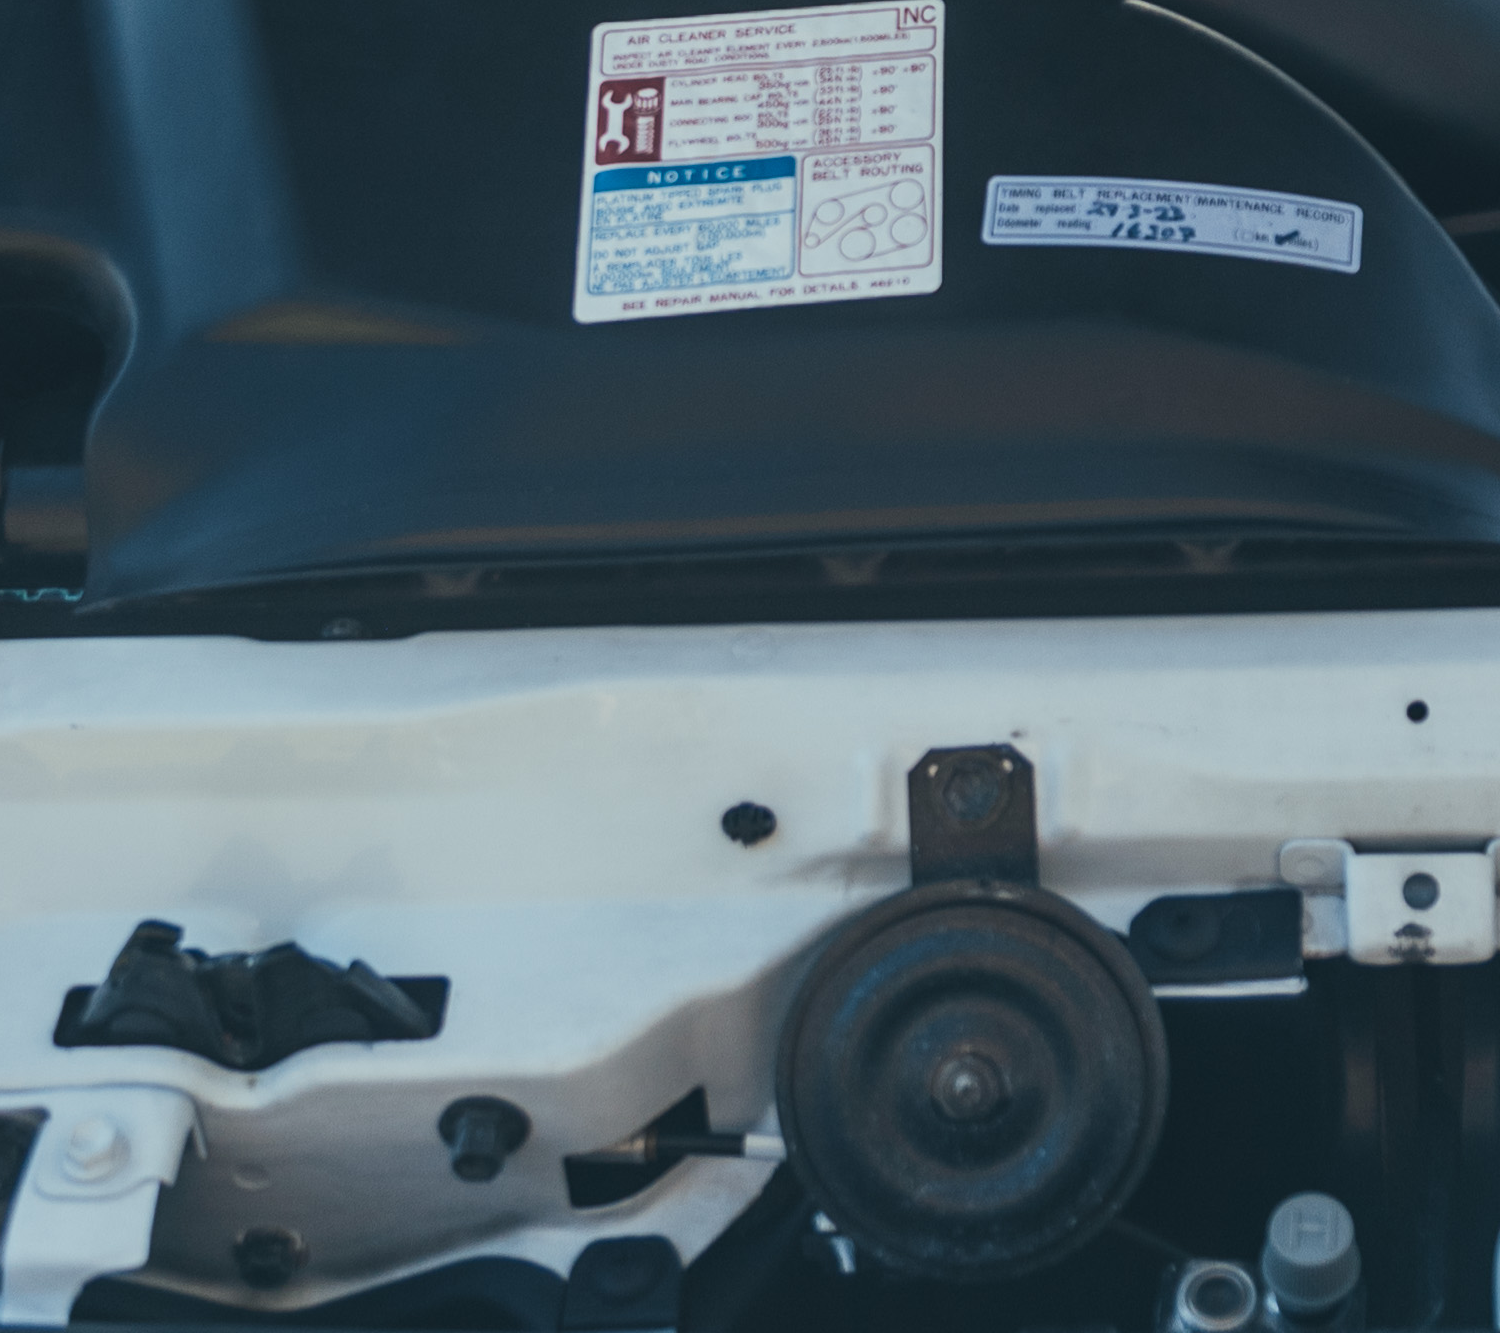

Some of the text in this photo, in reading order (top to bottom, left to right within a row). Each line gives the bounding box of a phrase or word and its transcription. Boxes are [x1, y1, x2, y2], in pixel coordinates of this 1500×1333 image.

[903, 5, 936, 24] NC
[627, 23, 798, 46] AIR CLEANER SERVICE
[775, 41, 807, 50] EVERY
[813, 151, 901, 168] ACCESSORY
[647, 164, 747, 184] NOTICE
[812, 163, 924, 181] BELT ROUTING
[751, 183, 782, 192] PLUG
[1001, 188, 1042, 199] TIMING
[1053, 188, 1085, 200] BELT
[1097, 190, 1193, 205] REPLACEMENT
[999, 202, 1020, 214] Date
[654, 225, 692, 235] EVERY
[745, 218, 781, 227] MILES
[1057, 218, 1093, 231] reading
[615, 248, 637, 257] NOT
[644, 244, 689, 255] ADJUST
[623, 299, 647, 311] SEE
[655, 294, 702, 308] REPAIR
[710, 288, 762, 303] MANUAL
[769, 285, 798, 297] FOR
[803, 280, 859, 294] DETAILS
